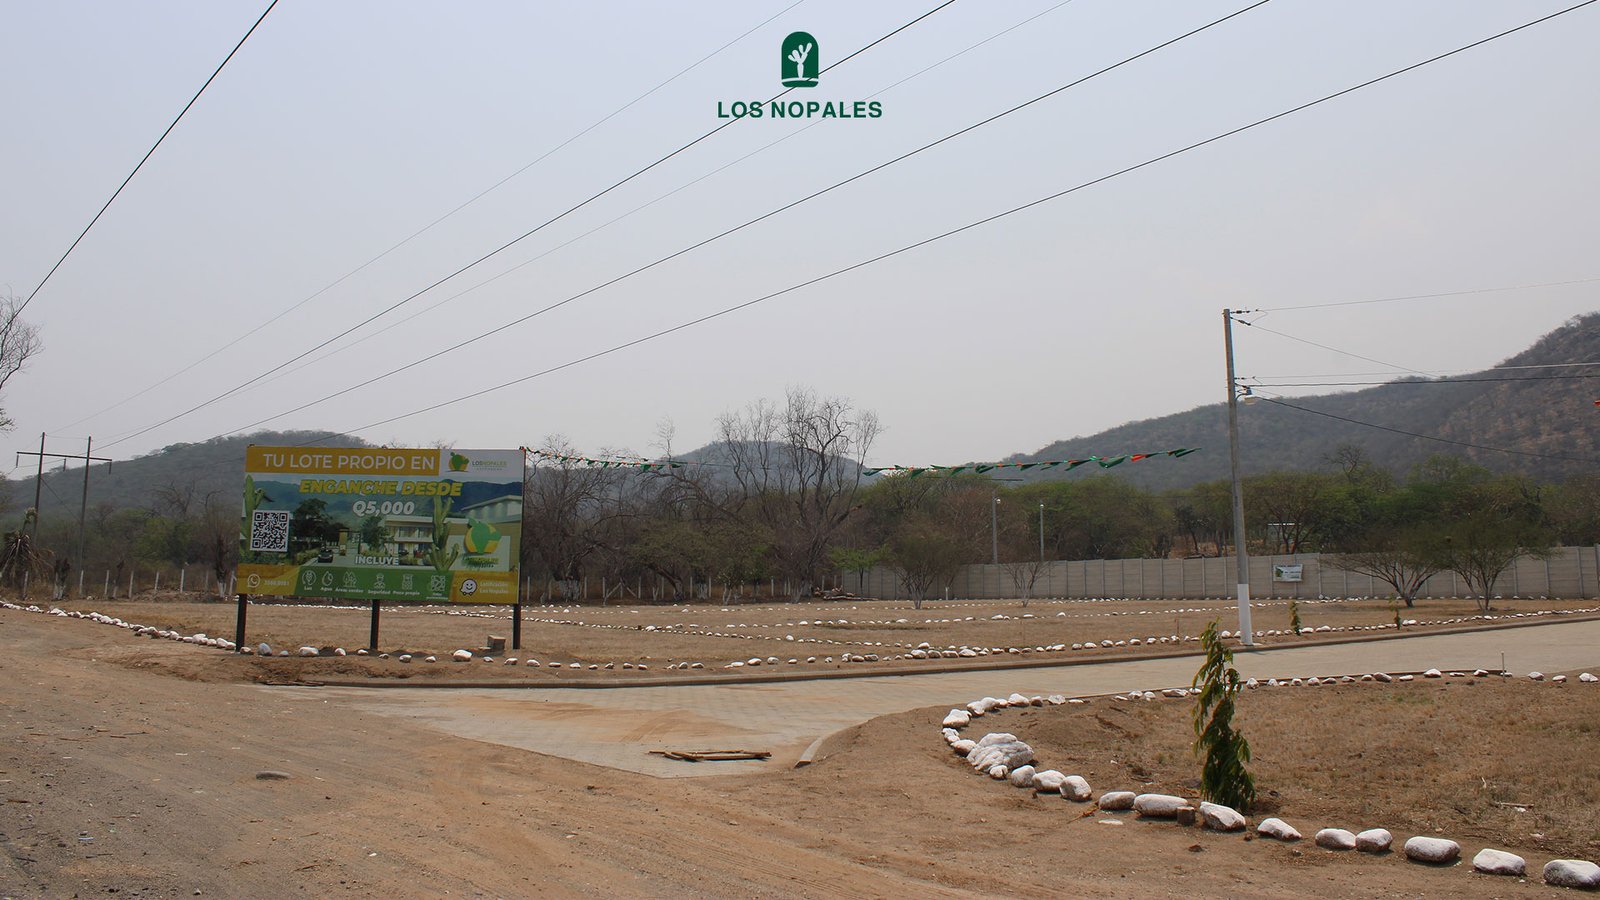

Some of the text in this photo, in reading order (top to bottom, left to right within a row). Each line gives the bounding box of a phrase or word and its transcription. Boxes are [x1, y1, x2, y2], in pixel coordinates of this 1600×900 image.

[263, 453, 435, 470] TU LOTE PROPIO EN
[299, 479, 463, 496] ENGANCHE DESDE
[352, 500, 415, 516] Q5,000
[355, 556, 400, 566] INCLUYE
